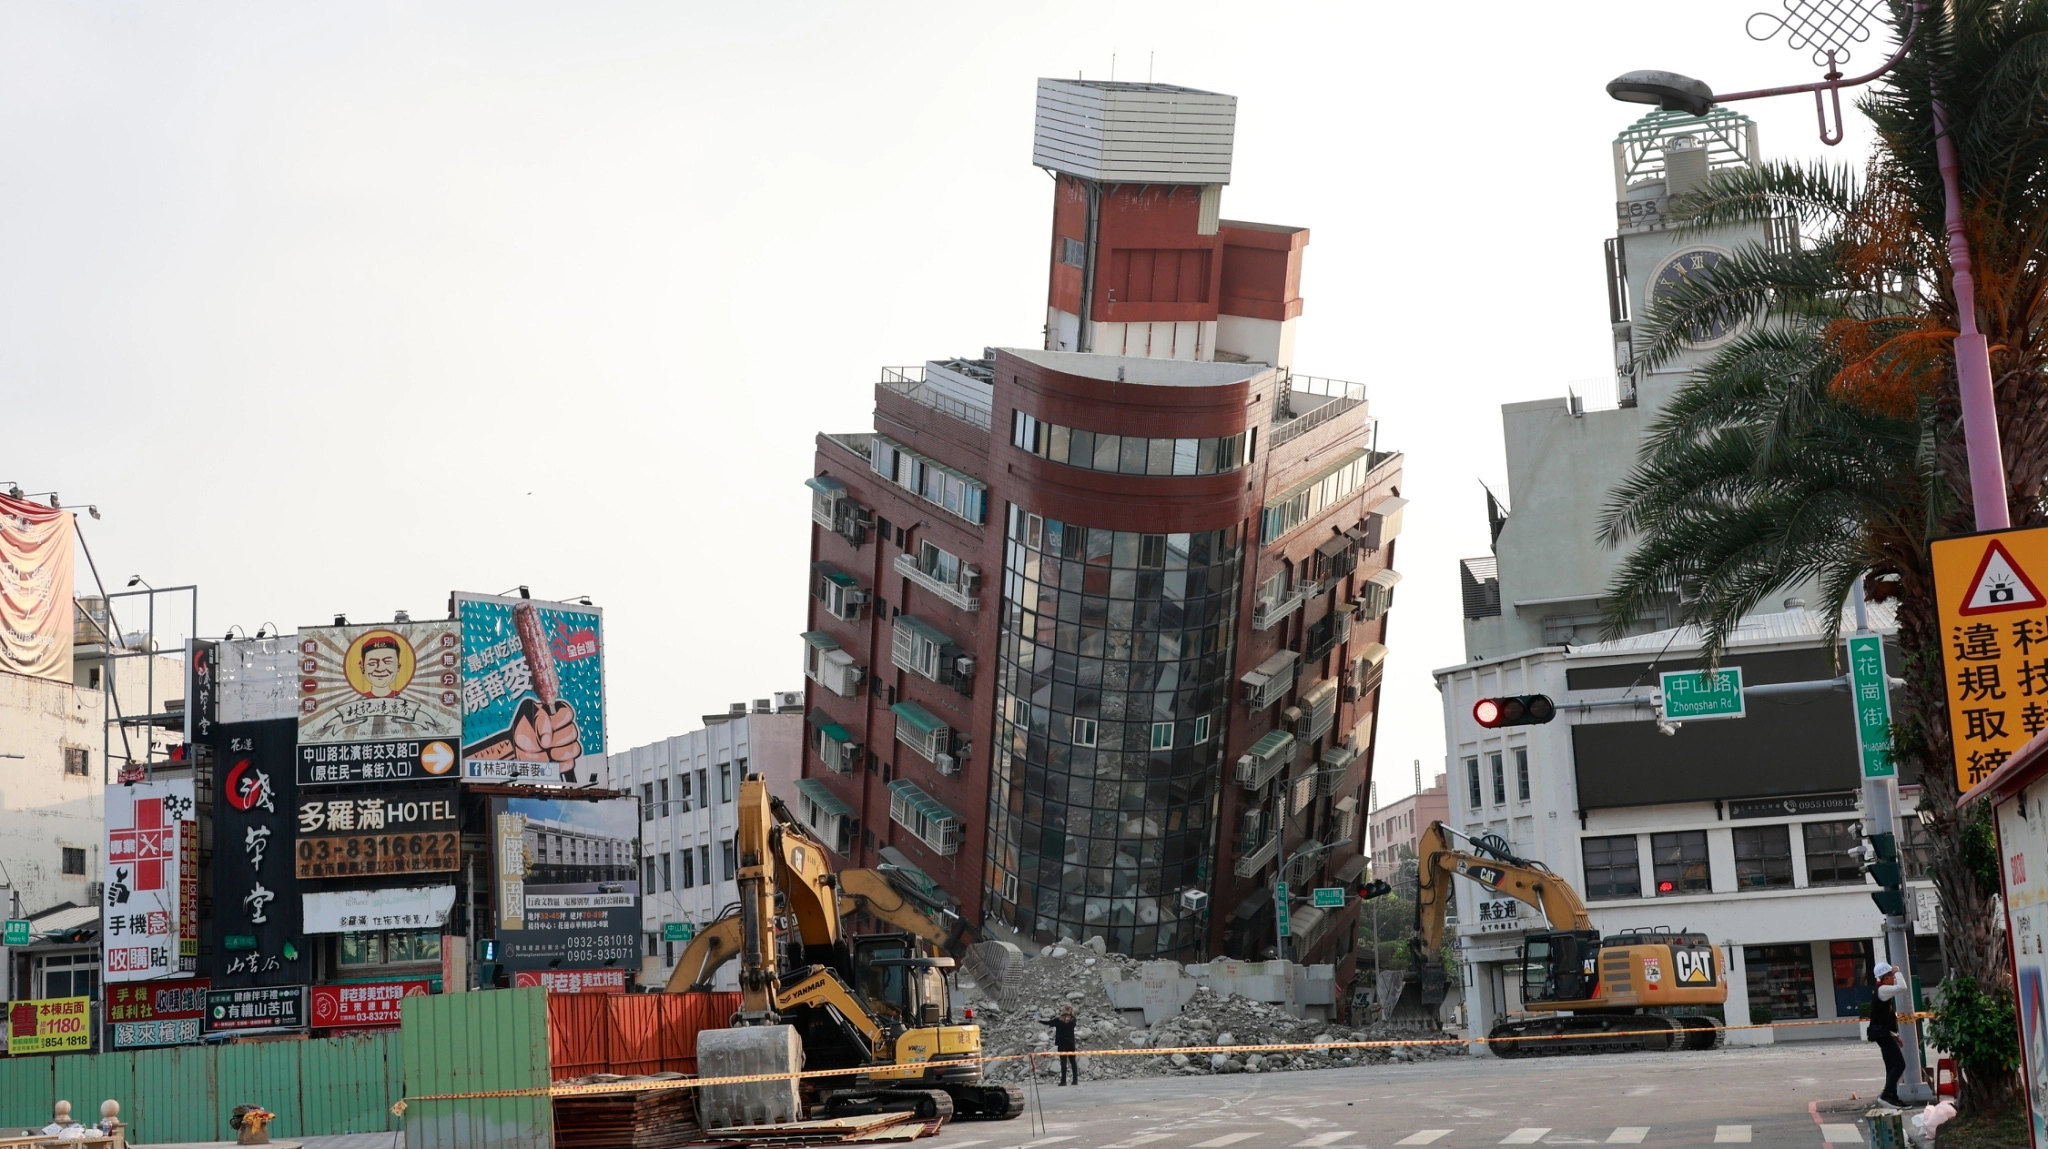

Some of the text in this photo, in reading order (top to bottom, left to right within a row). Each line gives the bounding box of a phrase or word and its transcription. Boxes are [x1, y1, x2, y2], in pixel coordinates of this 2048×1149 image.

[467, 635, 523, 673] 最好吃的
[304, 642, 316, 711] 僅此一家
[443, 635, 455, 704] 別無分號
[462, 656, 534, 717] 燒番麥
[1673, 674, 1731, 696] 中山路
[1858, 656, 1883, 726] 花崗街
[1673, 701, 1718, 714] Zhongshan
[1953, 623, 2009, 785] 違規取締
[230, 738, 254, 752] 花蓮
[303, 742, 419, 763] 中山路北濱街交叉路口
[310, 761, 412, 781] (原住民一條街入口)
[483, 762, 541, 777] 林記燒番麥
[1799, 799, 1854, 810] 0955109812
[298, 798, 456, 833] 多羅滿 HOTEL
[299, 833, 456, 861] 03-8316622
[1480, 867, 1496, 884] CAT
[1480, 901, 1517, 921] 黑金通
[567, 934, 634, 948] 0932-581018
[226, 951, 280, 975] 山苦瓜
[567, 948, 634, 962] 0905-935071
[1582, 959, 1596, 974] AT
[1676, 950, 1711, 981] CAT
[117, 987, 147, 1002] 手機
[234, 989, 278, 1003] 健康伴手禮
[792, 978, 826, 999] YANMAR
[40, 1001, 84, 1016] 本棟店面
[112, 1003, 153, 1020] 福利社
[227, 1000, 294, 1019] 有機山苦瓜
[10, 1003, 38, 1037] 售
[46, 1017, 81, 1034] 1180
